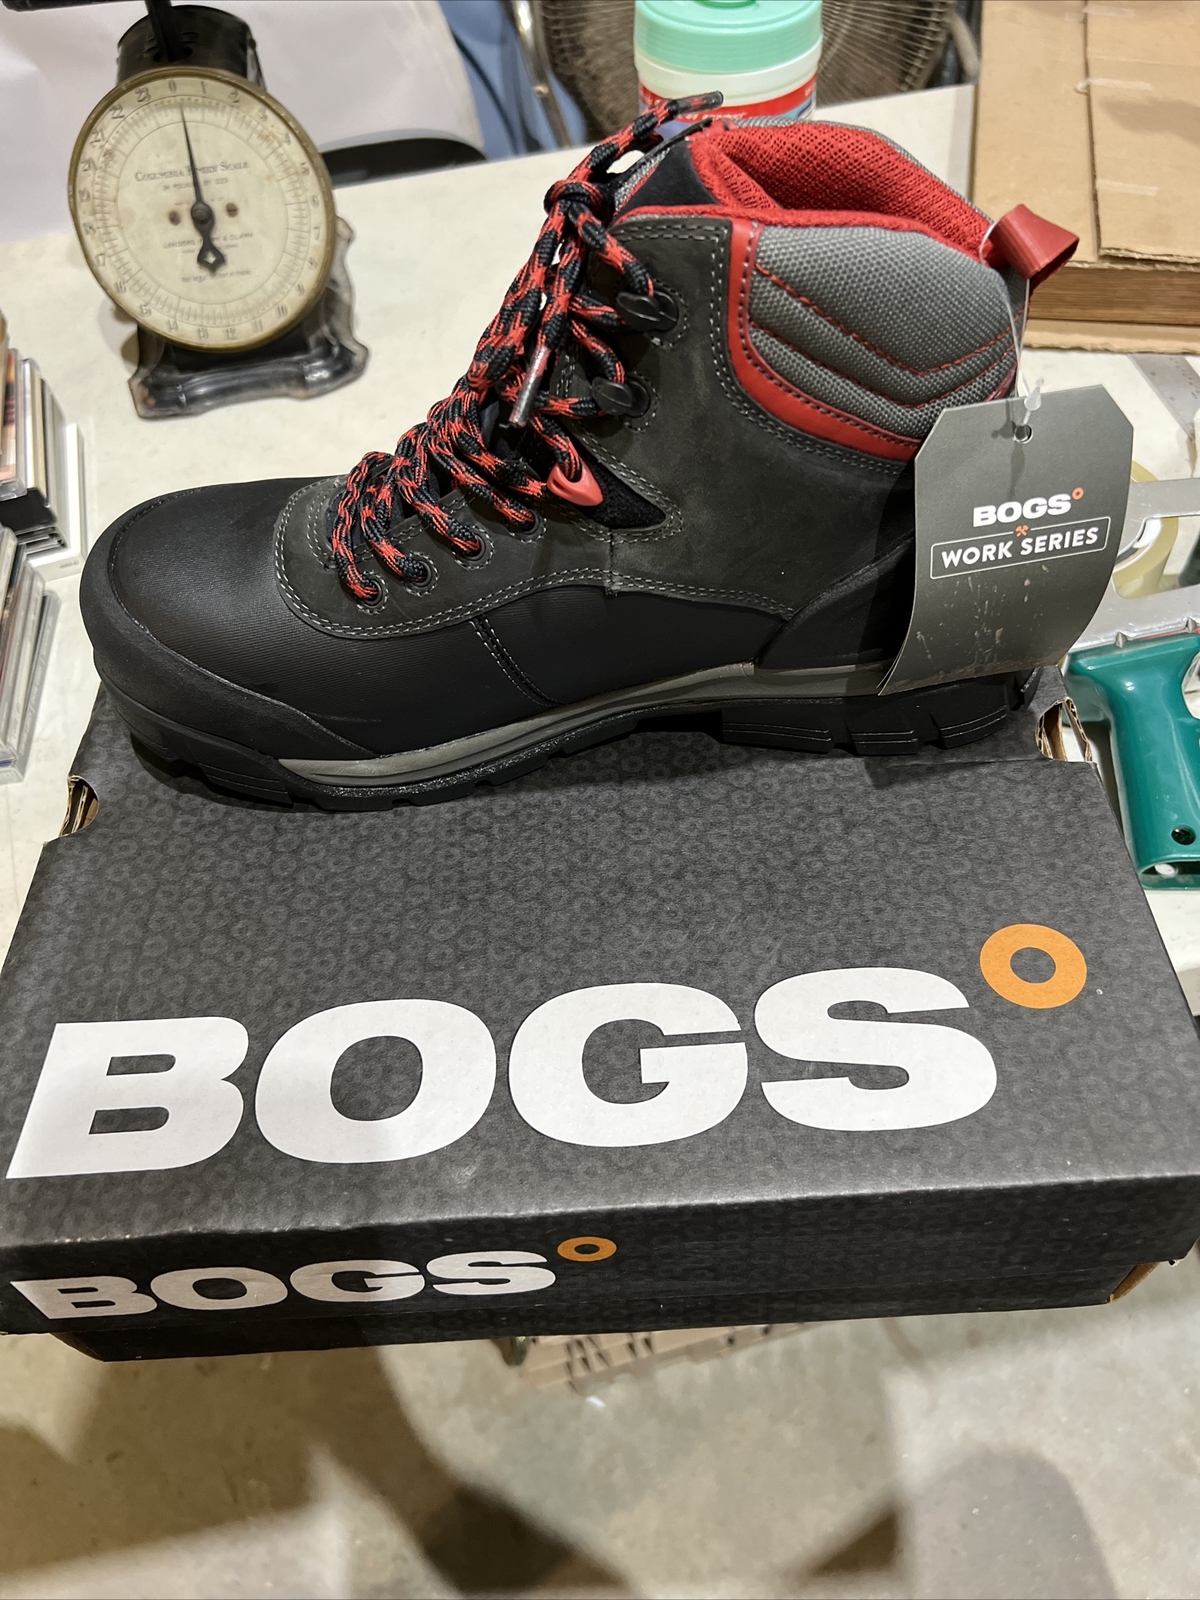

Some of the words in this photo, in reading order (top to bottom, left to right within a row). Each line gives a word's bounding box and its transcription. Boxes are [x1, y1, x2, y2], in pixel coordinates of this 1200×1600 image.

[973, 494, 1072, 527] BOGS
[941, 541, 1013, 569] WORK
[1020, 527, 1099, 556] SERIES
[6, 967, 997, 1179] BOGS
[10, 1251, 556, 1320] BOGS
